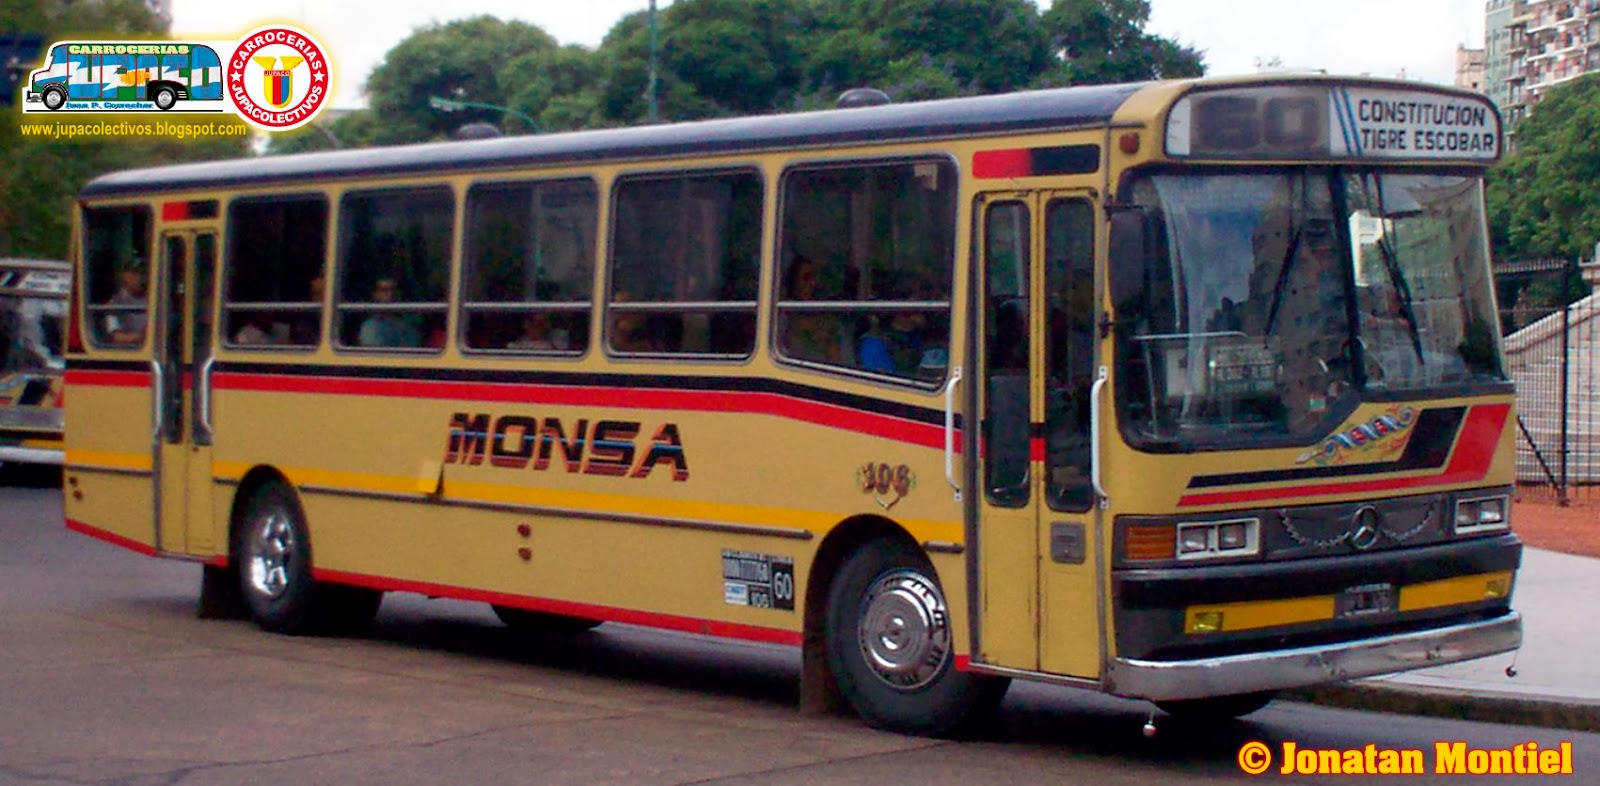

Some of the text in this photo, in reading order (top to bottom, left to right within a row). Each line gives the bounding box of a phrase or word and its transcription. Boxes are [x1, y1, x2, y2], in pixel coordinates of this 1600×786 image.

[1358, 99, 1486, 127] CONSTITUCION
[1361, 128, 1494, 151] TIGRE ESCOBAR
[445, 412, 689, 482] MONSA
[774, 571, 793, 600] 60
